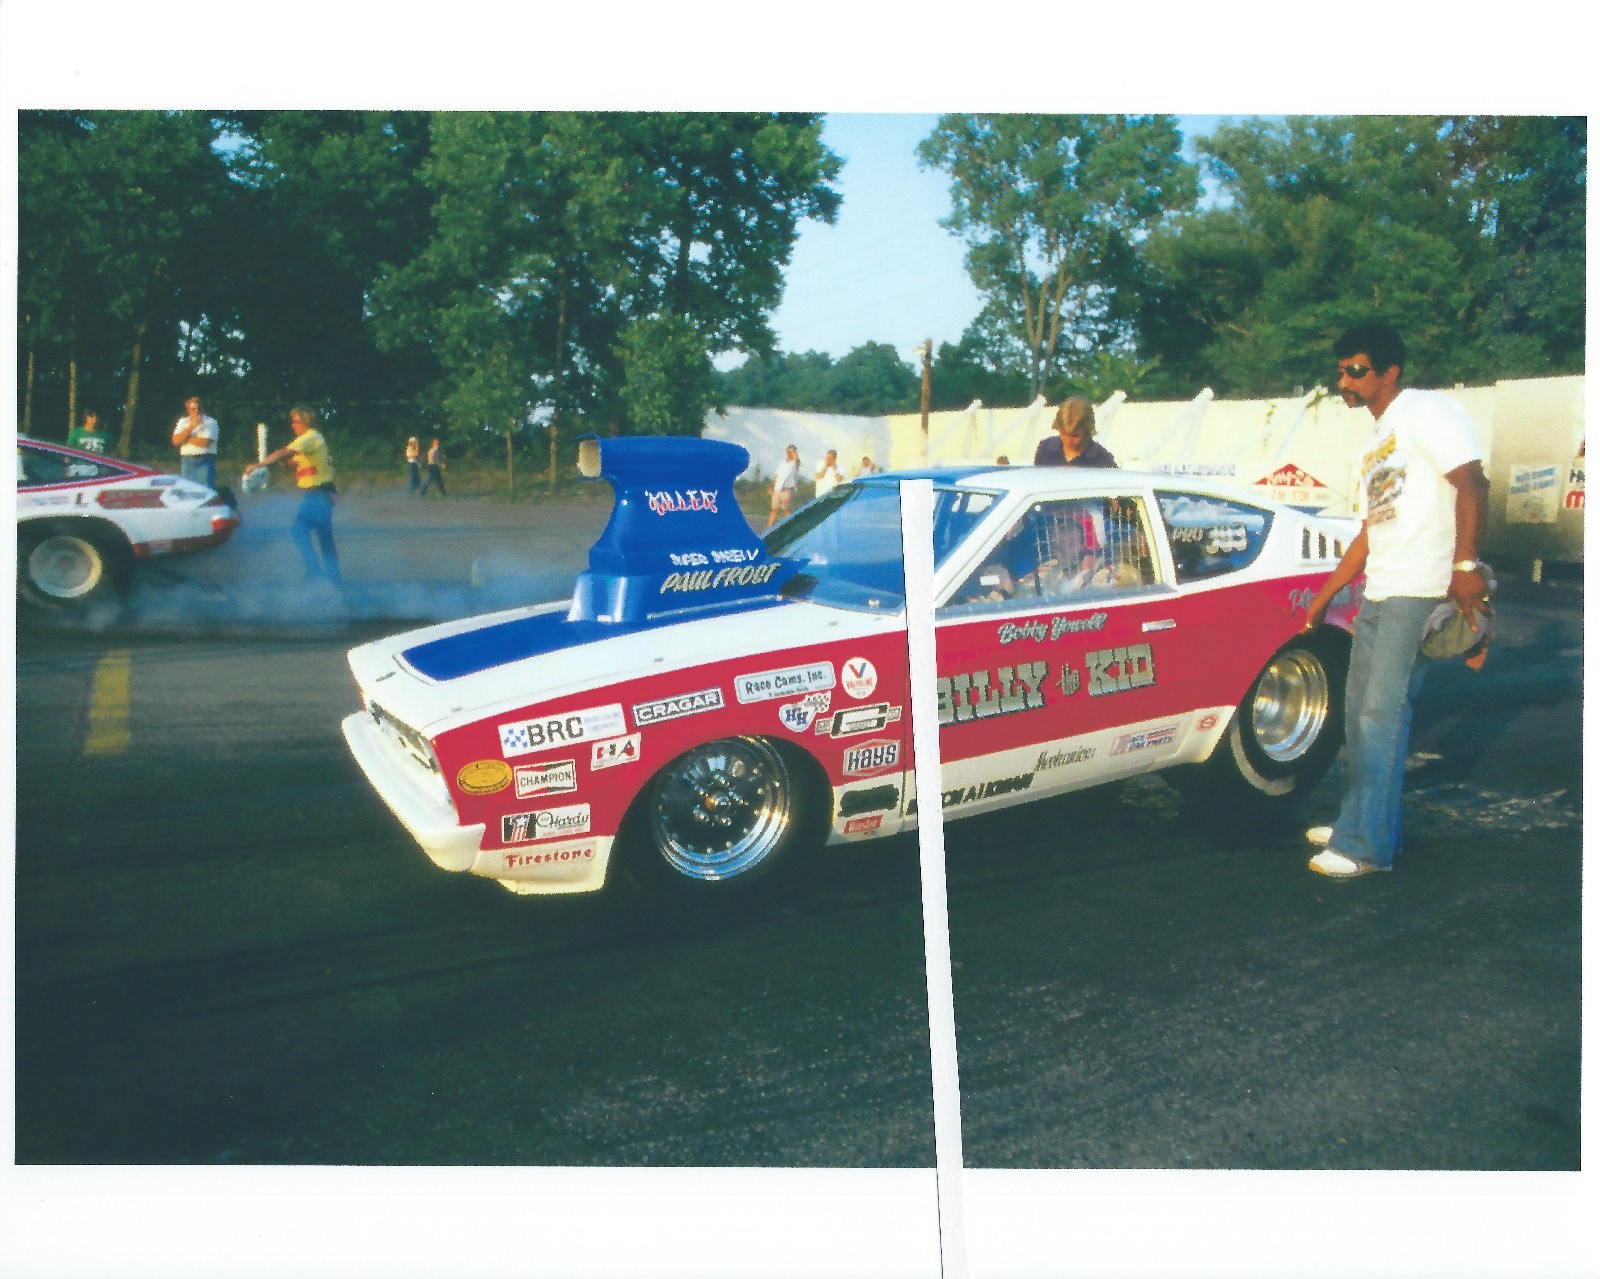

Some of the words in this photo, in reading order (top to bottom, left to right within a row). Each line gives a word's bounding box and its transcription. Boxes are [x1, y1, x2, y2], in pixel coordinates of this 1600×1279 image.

[660, 569, 714, 594] PAUL
[713, 562, 782, 588] FROST
[998, 622, 1048, 645] Bobby
[745, 680, 772, 695] Race
[937, 660, 1048, 728] BILLY
[1085, 643, 1156, 697] KID
[638, 692, 719, 719] CRAGAR
[526, 716, 584, 747] BRC
[520, 771, 574, 788] CHAMPION
[505, 848, 592, 869] Firestone
